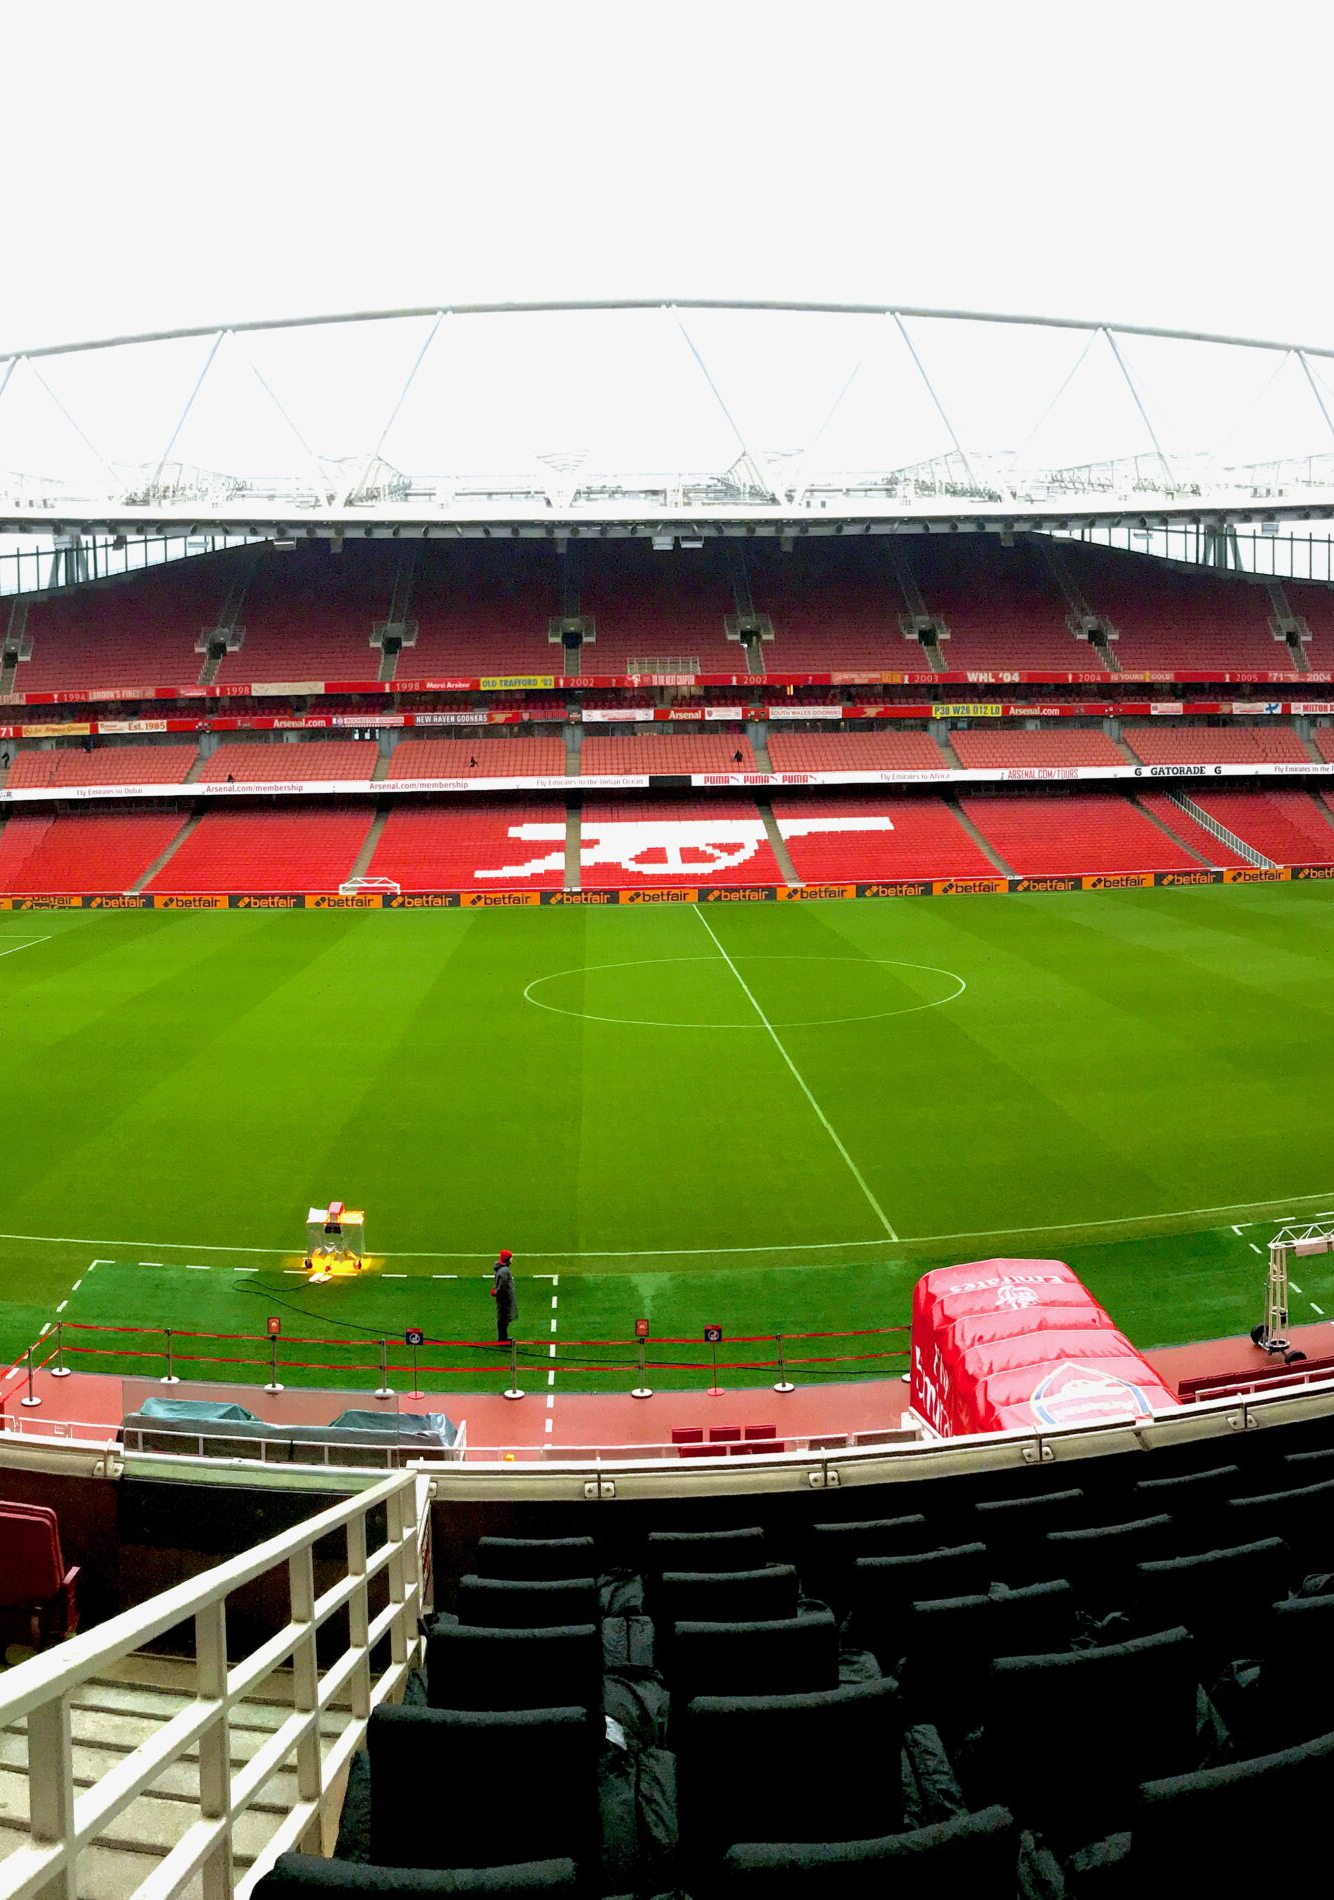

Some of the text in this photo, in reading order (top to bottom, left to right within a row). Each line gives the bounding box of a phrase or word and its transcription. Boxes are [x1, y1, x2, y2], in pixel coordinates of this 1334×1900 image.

[570, 678, 595, 687] 2002
[743, 676, 768, 685] 2002
[914, 674, 939, 683] 2003
[967, 671, 996, 683] WHL
[1078, 673, 1101, 682] 2004
[1236, 673, 1259, 682] 2005
[1307, 672, 1331, 682] 2004
[396, 682, 420, 691] 1998
[482, 679, 538, 688] OLD TRAFFORD
[226, 686, 250, 696] 1998
[63, 692, 87, 703] 1994
[668, 709, 702, 720] Arsenal
[934, 705, 971, 716] P38 W26
[1009, 705, 1060, 716] Arsenal.com
[273, 718, 327, 730] Arsenal.com
[416, 713, 488, 724] NEW HAVEN GOONERS
[145, 720, 166, 731] 1985
[0, 726, 15, 737] 71
[1150, 766, 1206, 776] GATORADE
[703, 774, 809, 785] PUMA PUMA PUMA
[206, 783, 304, 793] Arsenal.com/membership
[369, 780, 469, 791] Arsenal.com/membership
[1173, 873, 1217, 886] betfair
[1243, 870, 1284, 882] betfair
[954, 881, 1000, 893] betfair
[1029, 879, 1074, 891] betfair
[1103, 876, 1146, 888] betfair
[720, 889, 769, 901] betfair
[800, 887, 847, 899] betfair
[878, 884, 925, 897] betfair
[102, 896, 146, 908] betfair
[175, 896, 221, 908] betfair
[251, 896, 297, 908] betfair
[327, 896, 374, 908] betfair
[403, 895, 452, 907] betfair
[483, 894, 531, 906] betfair
[562, 892, 610, 904] betfair
[642, 891, 690, 903] betfair
